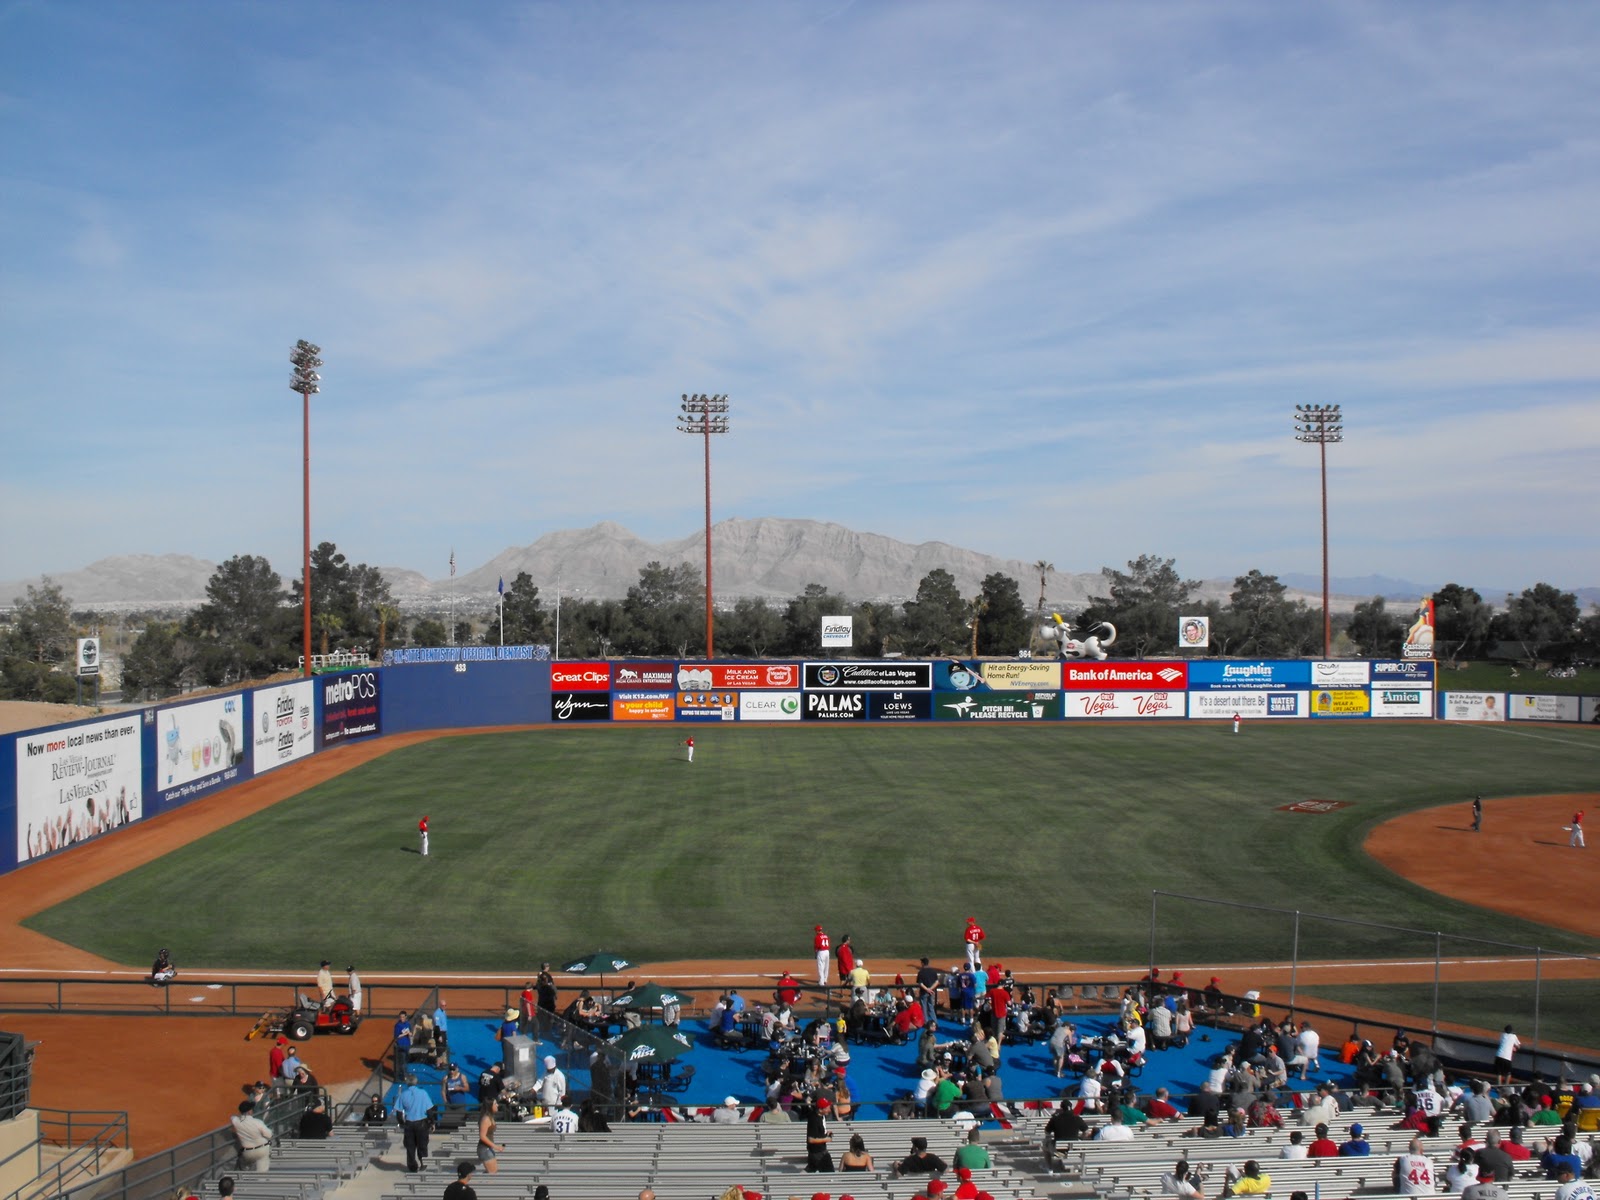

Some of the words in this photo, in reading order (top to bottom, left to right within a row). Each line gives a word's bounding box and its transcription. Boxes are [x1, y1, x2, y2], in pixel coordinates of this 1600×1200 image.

[824, 625, 851, 633] Findlay
[394, 648, 420, 664] ON-SITE
[420, 647, 461, 662] DENTISTRY
[461, 647, 496, 661] OFFICIAL
[497, 646, 534, 660] DENTIST
[1404, 649, 1433, 658] Cannery
[454, 663, 467, 672] 433
[842, 666, 879, 678] Cadillac
[898, 670, 916, 678] Vegas
[1007, 664, 1050, 673] Energy-Saving
[1222, 662, 1271, 677] Laughlin
[1375, 663, 1417, 672] SUPERCUTS
[552, 672, 582, 682] Great
[583, 671, 608, 684] Clips
[1069, 669, 1096, 681] Bank
[1097, 669, 1109, 681] of
[1109, 669, 1153, 681] America
[326, 673, 376, 706] metroPCS
[1010, 681, 1049, 689] NVEnergy.com
[809, 694, 862, 711] PALMS
[1199, 696, 1207, 706] It's
[1209, 698, 1212, 706] a
[1213, 696, 1230, 706] desert
[1232, 696, 1240, 706] out
[1242, 696, 1256, 706] there.
[1258, 696, 1265, 706] Be
[1384, 692, 1418, 702] Amica
[277, 695, 295, 714] Findlay
[626, 702, 643, 710] your
[1080, 697, 1118, 715] Vegas
[1133, 697, 1172, 715] Vegas
[277, 716, 293, 727] TOYOTA
[27, 743, 44, 757] Now
[46, 740, 66, 753] more
[67, 733, 84, 748] local
[85, 731, 104, 744] news
[104, 728, 119, 742] than
[120, 726, 136, 739] ever.
[278, 731, 295, 747] Findlay
[52, 755, 116, 781] REVIEW-JOURNAL
[60, 788, 74, 804] LAS
[74, 783, 94, 799] VEGAS
[94, 779, 108, 794] SUN
[821, 939, 829, 947] 44
[630, 1048, 656, 1061] Mist
[556, 1121, 570, 1133] 31
[1408, 1169, 1430, 1185] 44
[1477, 1189, 1498, 1198] WILLIS
